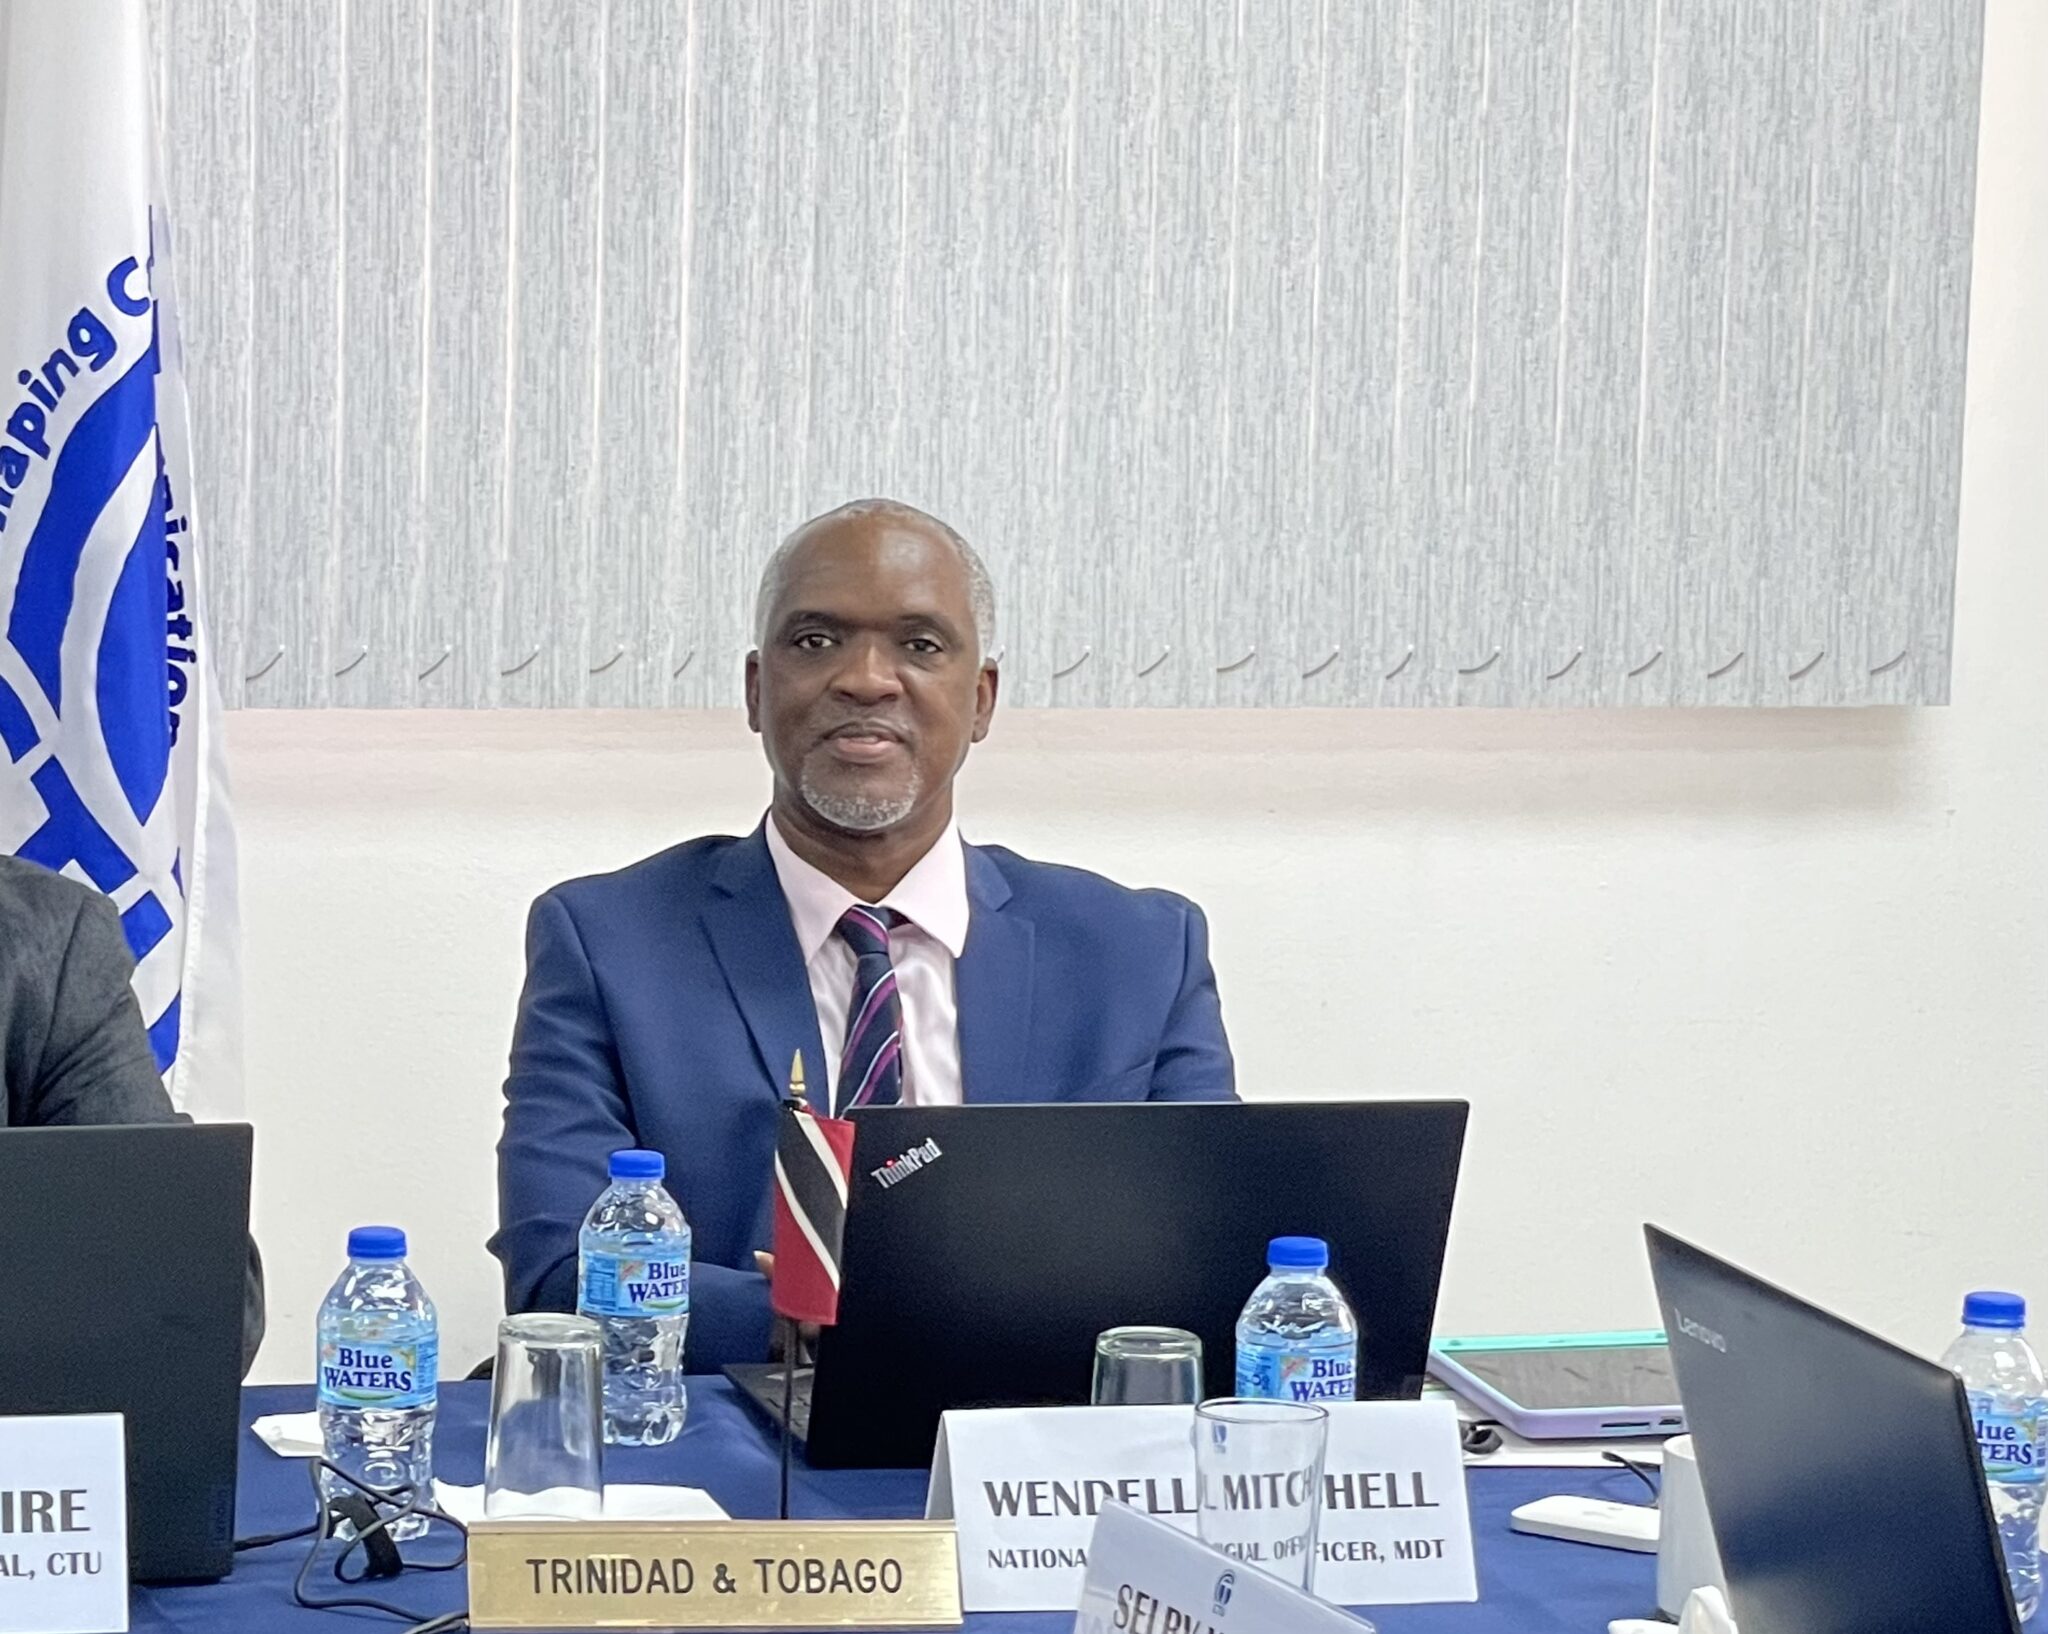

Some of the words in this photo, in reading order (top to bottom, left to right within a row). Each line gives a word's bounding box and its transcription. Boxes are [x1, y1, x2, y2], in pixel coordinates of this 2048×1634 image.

[870, 1137, 942, 1189] ThinkPad
[648, 1262, 686, 1280] Blue
[1674, 1307, 1727, 1353] Lenovo
[339, 1348, 393, 1369] Blue
[1312, 1359, 1352, 1378] Blue
[324, 1367, 412, 1392] WATERS
[1977, 1420, 2016, 1441] lue
[1977, 1443, 2032, 1465] TERS
[983, 1478, 1198, 1516] WENDELL
[1222, 1469, 1439, 1511] MITCHELL
[1, 1489, 91, 1533] IRE
[47, 1552, 102, 1576] CTU
[988, 1549, 1088, 1569] NATIONA
[1394, 1540, 1445, 1560] MDT
[526, 1559, 695, 1594] TRINIDAD
[712, 1563, 736, 1594] &
[753, 1559, 901, 1594] TOBAGO
